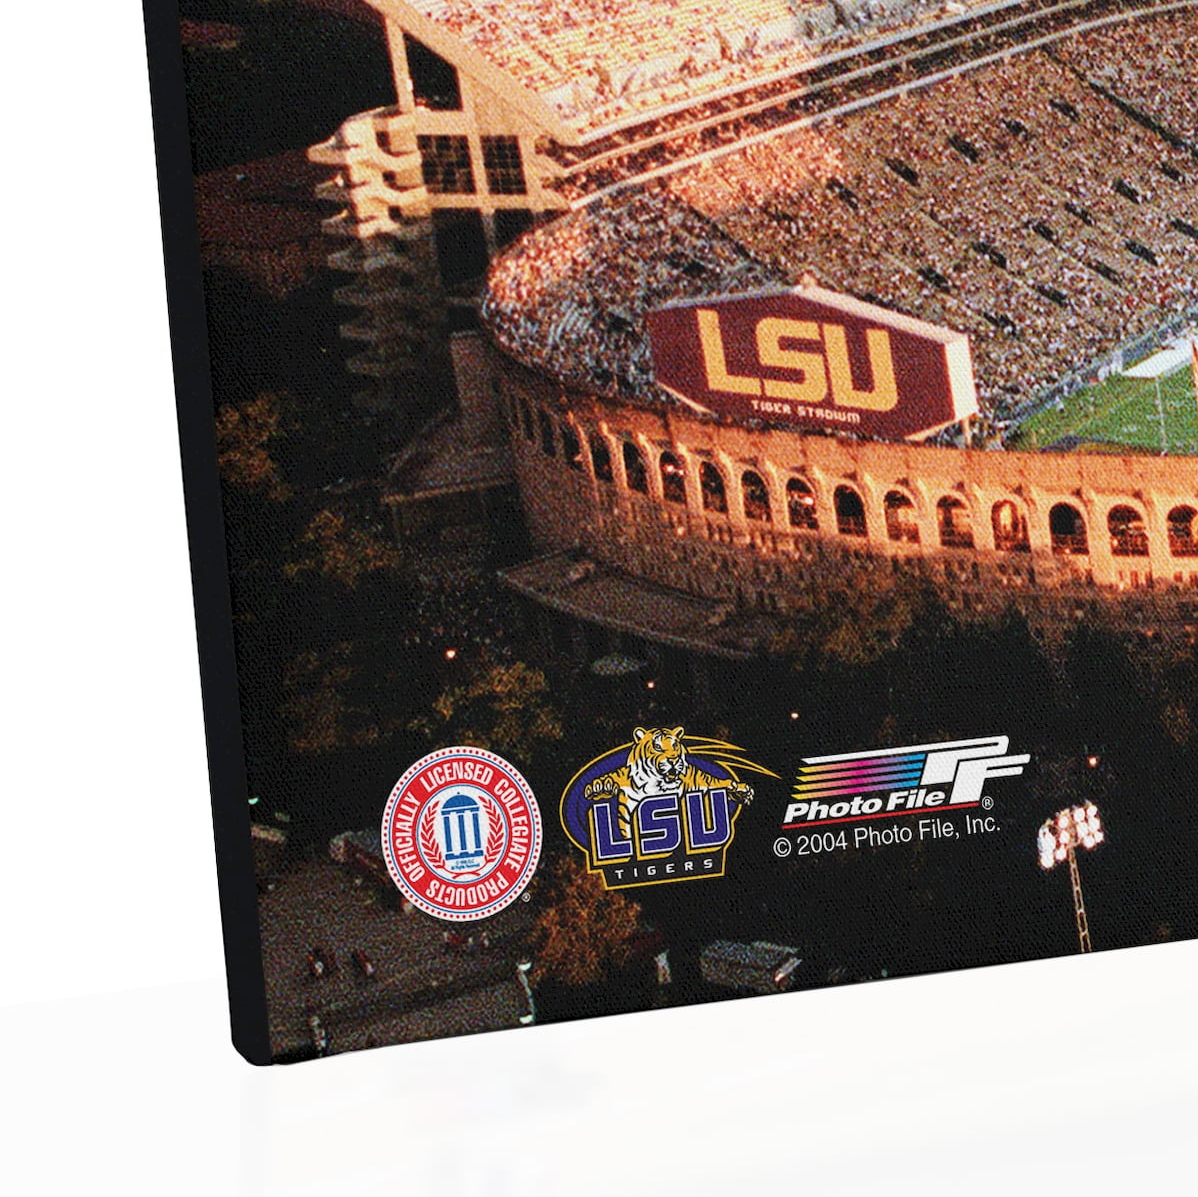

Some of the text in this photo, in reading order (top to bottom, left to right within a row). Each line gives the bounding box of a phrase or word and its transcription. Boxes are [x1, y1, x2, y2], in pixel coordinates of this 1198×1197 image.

[697, 309, 898, 412] LSU
[751, 401, 861, 424] TIGER STADIUM
[419, 762, 494, 792] LICENSED
[783, 796, 882, 824] Photo
[886, 789, 946, 811] File
[395, 791, 426, 883] OFFICIALLY
[494, 778, 529, 873] COLLEGIATE
[592, 789, 731, 863] LSU
[797, 830, 848, 855] 2004
[854, 823, 912, 848] Photo
[918, 818, 960, 840] File,
[966, 815, 1001, 834] Inc.
[615, 858, 713, 879] TIGERS
[425, 871, 510, 906] PRODUCTS
